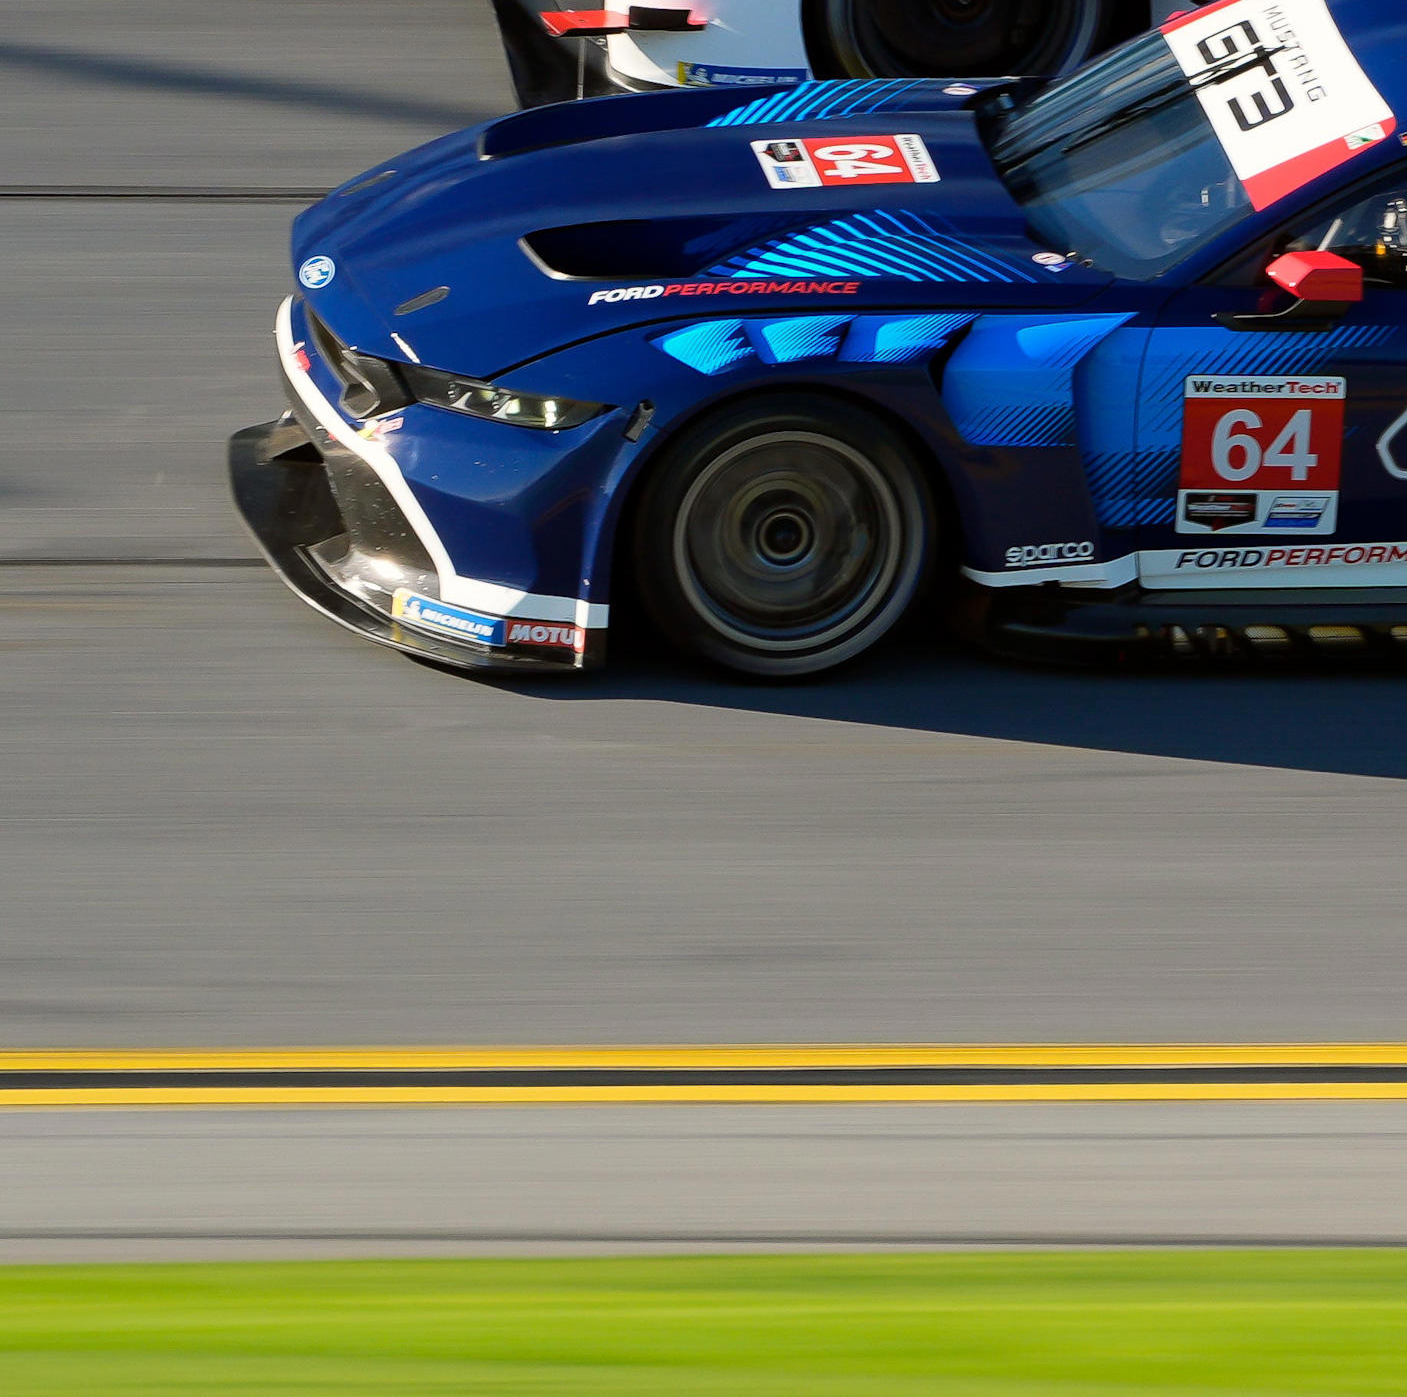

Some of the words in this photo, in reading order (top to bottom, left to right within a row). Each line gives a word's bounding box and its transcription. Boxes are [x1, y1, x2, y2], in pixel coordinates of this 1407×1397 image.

[1261, 4, 1328, 103] MUSTANG
[1196, 19, 1295, 132] GT3
[813, 143, 904, 179] 64
[1192, 380, 1339, 394] WeatherTech
[1210, 407, 1319, 482] 64
[1005, 541, 1095, 565] sparco
[420, 608, 495, 637] MICHELIN
